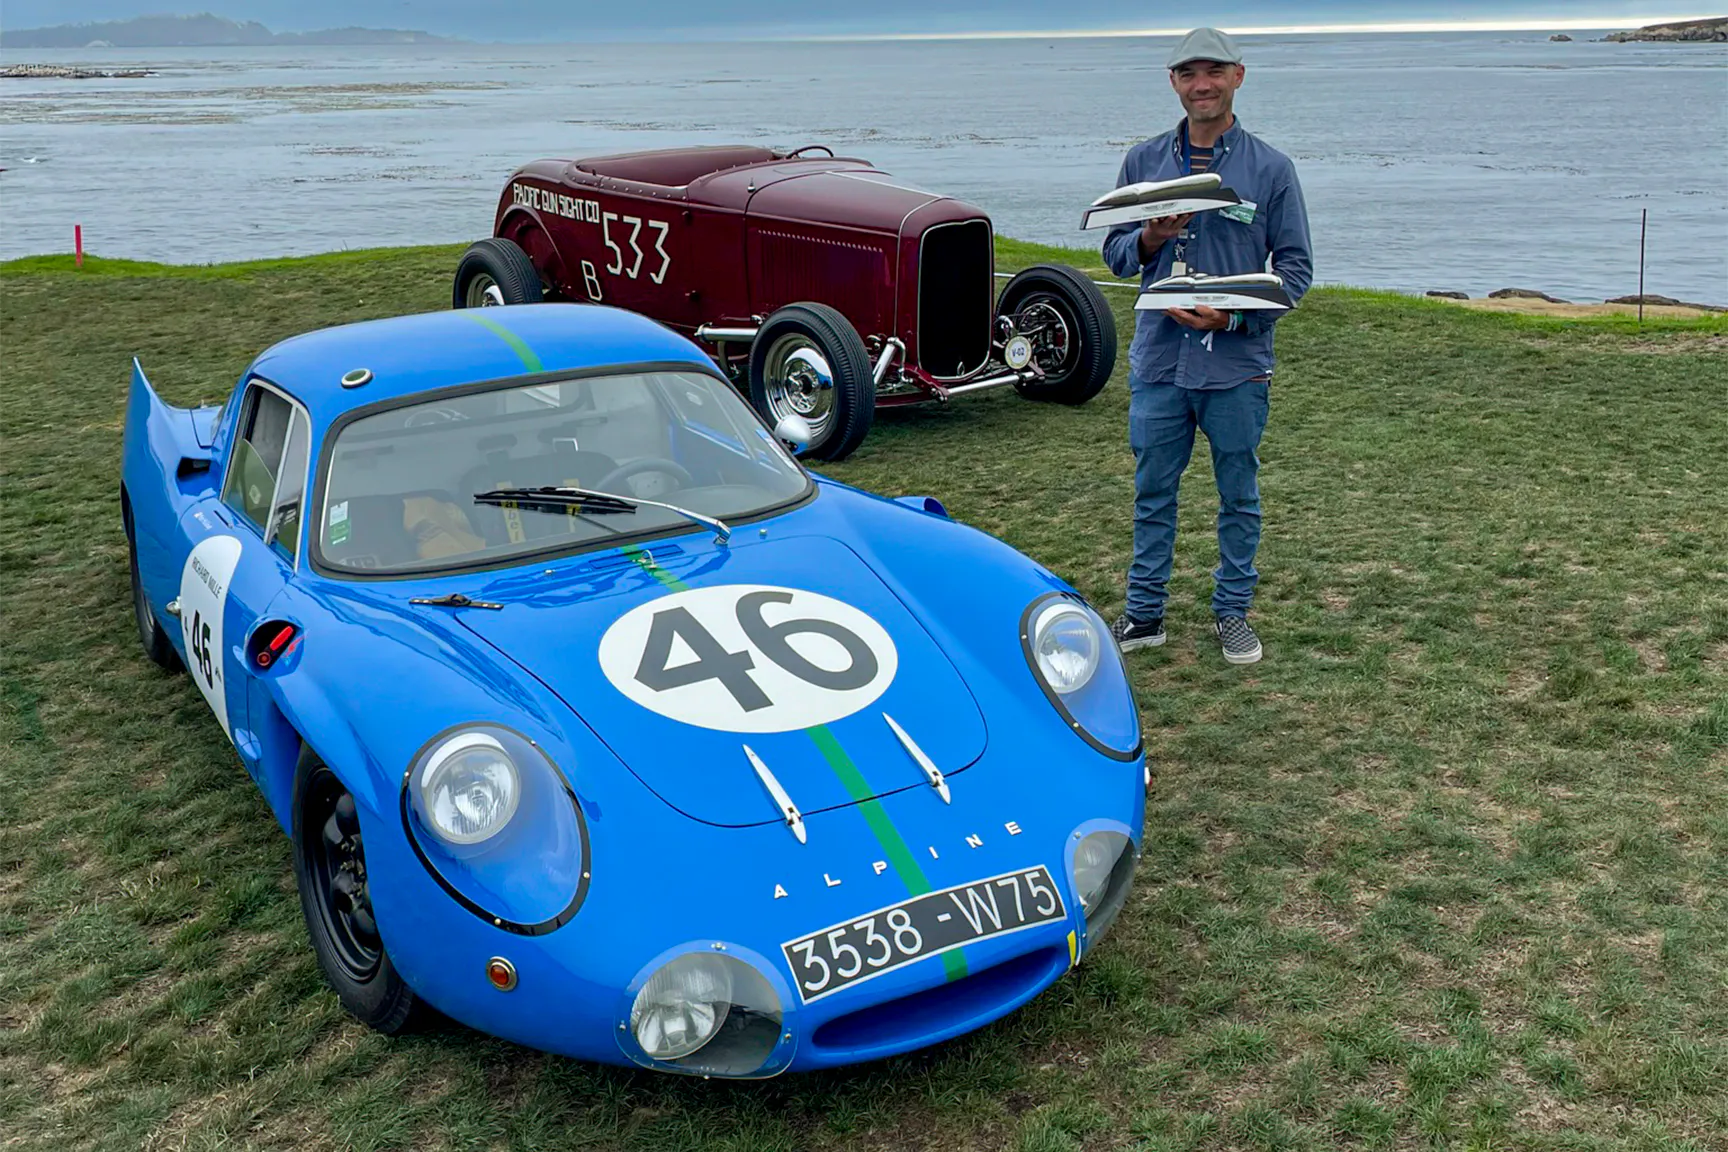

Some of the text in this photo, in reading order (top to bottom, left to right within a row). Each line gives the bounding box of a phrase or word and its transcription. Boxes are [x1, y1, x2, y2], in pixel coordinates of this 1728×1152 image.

[513, 183, 600, 224] PACIFIC GUN SIGHT CO
[581, 260, 602, 301] B
[602, 211, 671, 285] 533
[192, 556, 222, 599] RICHARD MILLE
[192, 609, 213, 690] 46
[633, 591, 879, 713] 46
[773, 821, 1022, 899] ALPINE
[792, 908, 923, 992] 3538
